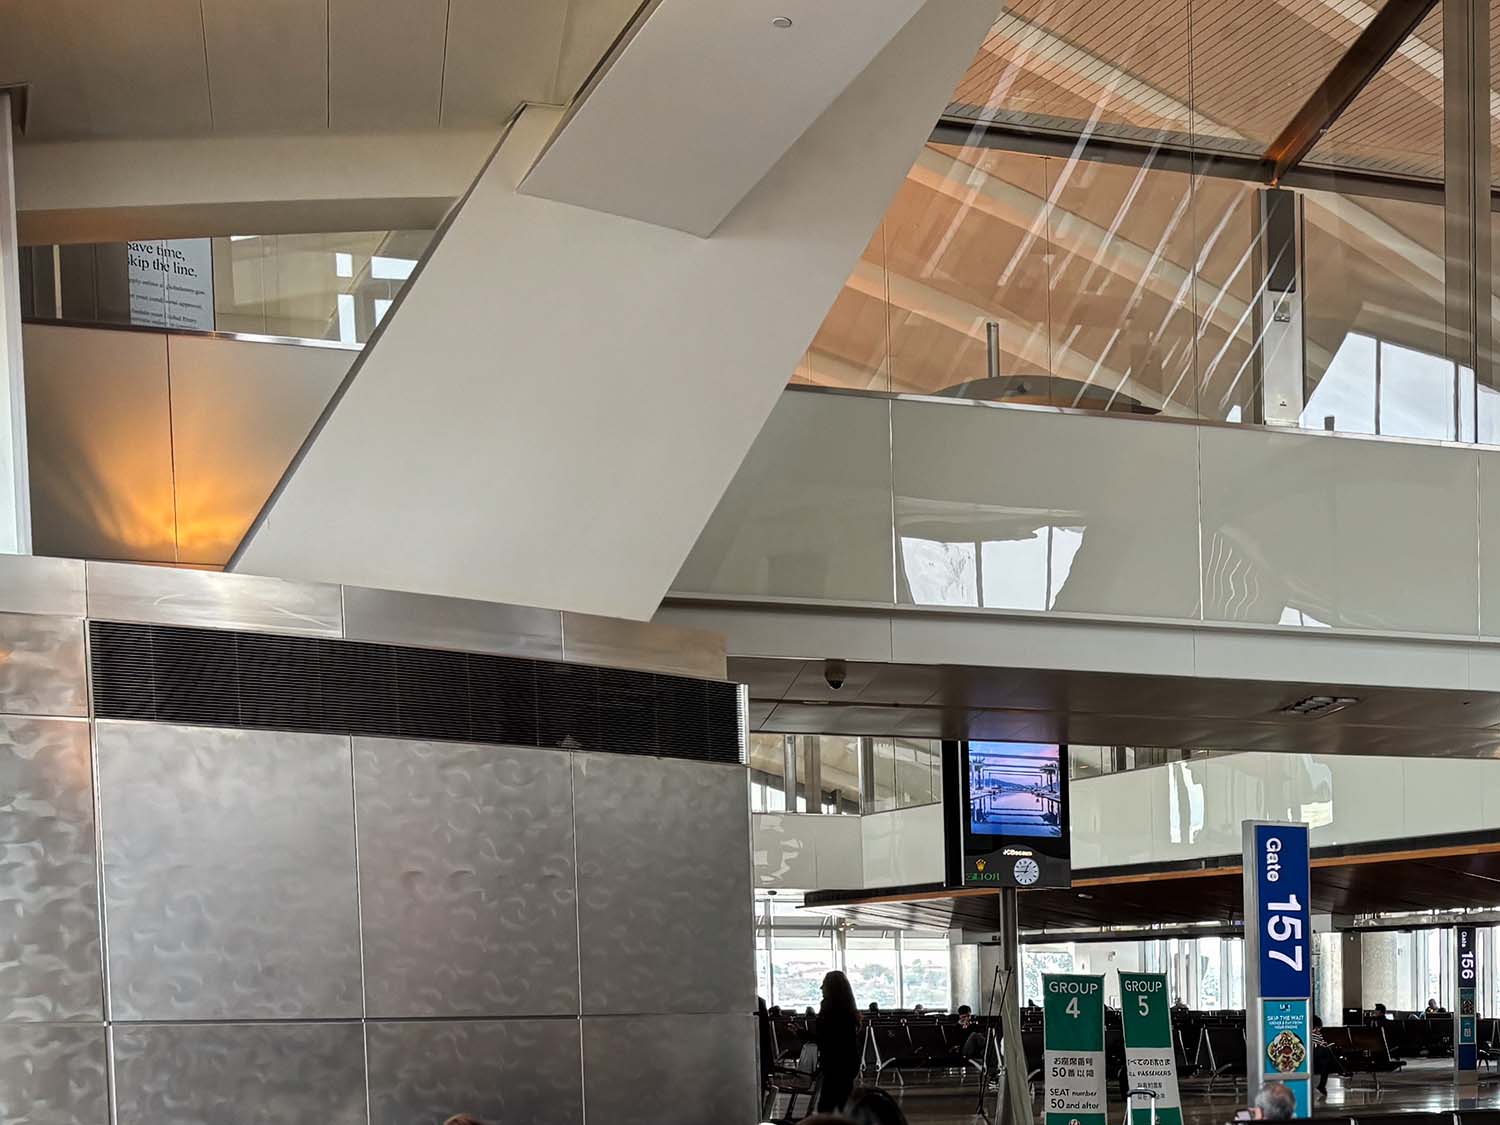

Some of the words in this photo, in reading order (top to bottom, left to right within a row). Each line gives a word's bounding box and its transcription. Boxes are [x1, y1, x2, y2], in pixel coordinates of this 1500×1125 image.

[157, 244, 185, 262] time,
[128, 254, 149, 271] kip
[153, 258, 170, 272] the
[173, 261, 198, 278] line.
[1266, 836, 1282, 882] Gate
[1267, 894, 1304, 972] 157
[1461, 951, 1474, 979] 156
[1049, 981, 1098, 995] GROUP
[1124, 980, 1162, 993] GROUP
[1065, 997, 1081, 1018] 4
[1138, 995, 1150, 1016] 5
[1050, 1088, 1070, 1096] SEAT
[1051, 1098, 1065, 1109] 50
[1066, 1101, 1080, 1109] and
